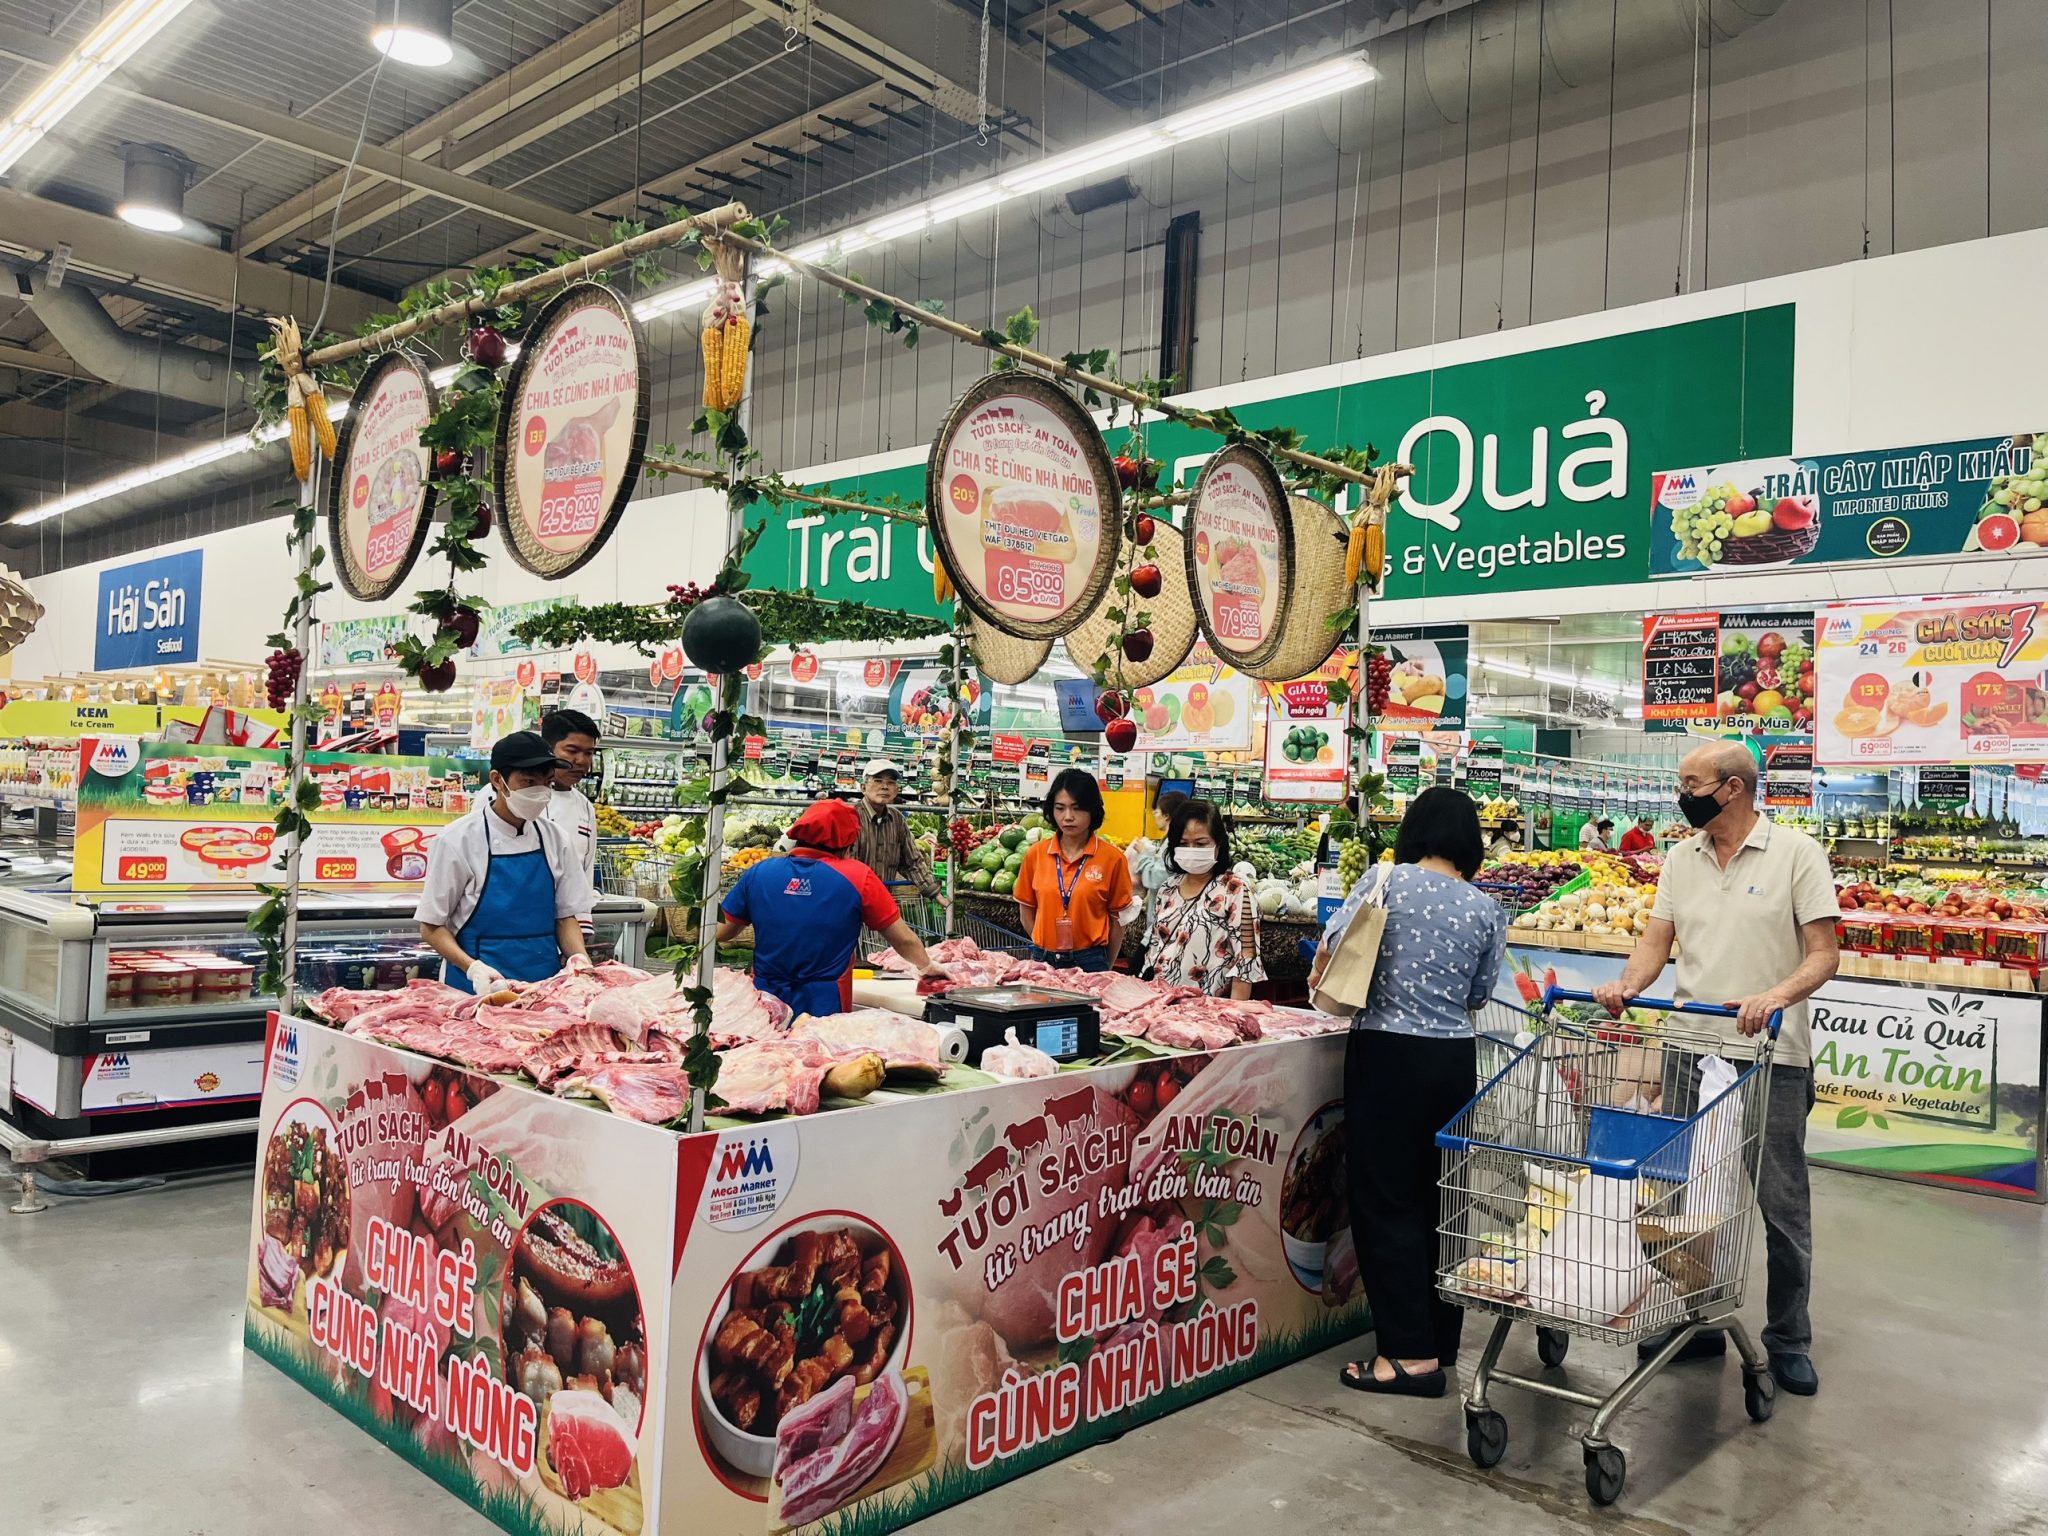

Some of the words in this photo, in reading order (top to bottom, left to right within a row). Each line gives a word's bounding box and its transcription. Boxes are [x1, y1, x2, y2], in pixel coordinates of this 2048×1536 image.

[595, 336, 606, 347] AN
[526, 391, 549, 410] CHIA
[565, 380, 588, 403] CÙNG
[591, 373, 609, 398] NHÀ
[613, 369, 637, 393] NÔNG
[353, 452, 370, 472] CHIA
[381, 434, 398, 458] CÙNG
[998, 422, 1024, 436] SẠCH
[1035, 429, 1049, 442] AN
[1052, 435, 1078, 459] TOÀN
[953, 449, 980, 472] CHIA
[985, 454, 999, 476] SẺ
[1001, 459, 1032, 483] CÙNG
[1035, 469, 1058, 489] NHÀ
[1062, 473, 1092, 496] NÔNG
[1396, 390, 1629, 532] Quả
[1764, 467, 1818, 500] TRÁI
[1824, 459, 1876, 495] CÂY
[1882, 451, 1952, 491] NHẬP
[1958, 439, 2032, 482] KHẨU
[953, 487, 976, 503] 20%
[1833, 495, 1899, 517] IMPORTED
[1902, 491, 1949, 511] FRUITS
[984, 535, 1001, 544] WAF
[1019, 528, 1034, 538] HEO
[1198, 511, 1212, 528] CHIA
[1223, 515, 1240, 535] CÙNG
[1242, 522, 1255, 538] NHÀ
[1258, 525, 1275, 542] NÔNG
[787, 511, 892, 588] Trái
[1403, 545, 1425, 575] &
[1432, 529, 1626, 578] Vegetables
[108, 585, 139, 636] Hải
[143, 577, 186, 630] Sản
[157, 636, 183, 653] Seafood
[1916, 613, 1960, 644] GIÁ
[1962, 609, 2013, 641] SỐC
[1860, 643, 1878, 655] 24
[1888, 641, 1906, 654] 26
[1656, 662, 1671, 676] Lê
[1288, 683, 1307, 695] GIÁ
[70, 720, 84, 728] Ice
[86, 721, 115, 729] Cream
[77, 707, 108, 718] KEM
[1306, 706, 1323, 716] ngày
[1651, 706, 1687, 716] KHUYẾN
[1690, 704, 1707, 715] MÃI
[1726, 713, 1754, 728] Bốn
[1760, 717, 1790, 729] Mùa
[1811, 1007, 1868, 1035] Rau
[1876, 1015, 1914, 1041] Củ
[1924, 1020, 1987, 1050] Quả
[1814, 1040, 1870, 1079] An
[1882, 1048, 1985, 1094] Toàn
[1843, 1085, 1883, 1101] Foods
[1888, 1094, 1897, 1103] &
[1901, 1093, 1981, 1115] Vegetables
[334, 1117, 374, 1162] TƯƠI
[379, 1111, 424, 1153] SẠCH
[442, 1127, 472, 1168] AN
[477, 1146, 531, 1221] TOÀN
[351, 1154, 365, 1188] từ
[367, 1155, 401, 1196] trang
[404, 1158, 430, 1192] trại
[432, 1164, 458, 1204] đến
[461, 1188, 489, 1227] bàn
[490, 1213, 513, 1250] ăn
[759, 1203, 775, 1211] Everyday
[937, 1171, 1029, 1273] TƯƠI
[1038, 1125, 1129, 1197] SẠCH
[1161, 1114, 1206, 1155] AN
[1211, 1113, 1280, 1167] TOÀN
[984, 1244, 1017, 1294] từ
[1020, 1204, 1092, 1259] trang
[1097, 1177, 1142, 1224] trại
[1147, 1159, 1188, 1205] đến
[1193, 1162, 1230, 1200] bàn
[1235, 1174, 1262, 1208] ăn
[366, 1216, 428, 1311] CHIA
[435, 1239, 478, 1338] SẺ
[1054, 1257, 1148, 1345] CHIA
[1153, 1222, 1199, 1312] SẺ
[309, 1282, 378, 1379] CÙNG
[381, 1318, 439, 1421] NHÀ
[445, 1354, 536, 1479] NÔNG
[966, 1356, 1081, 1470] CÙNG
[1085, 1329, 1164, 1423] NHÀ
[1172, 1299, 1260, 1383] NÔNG
